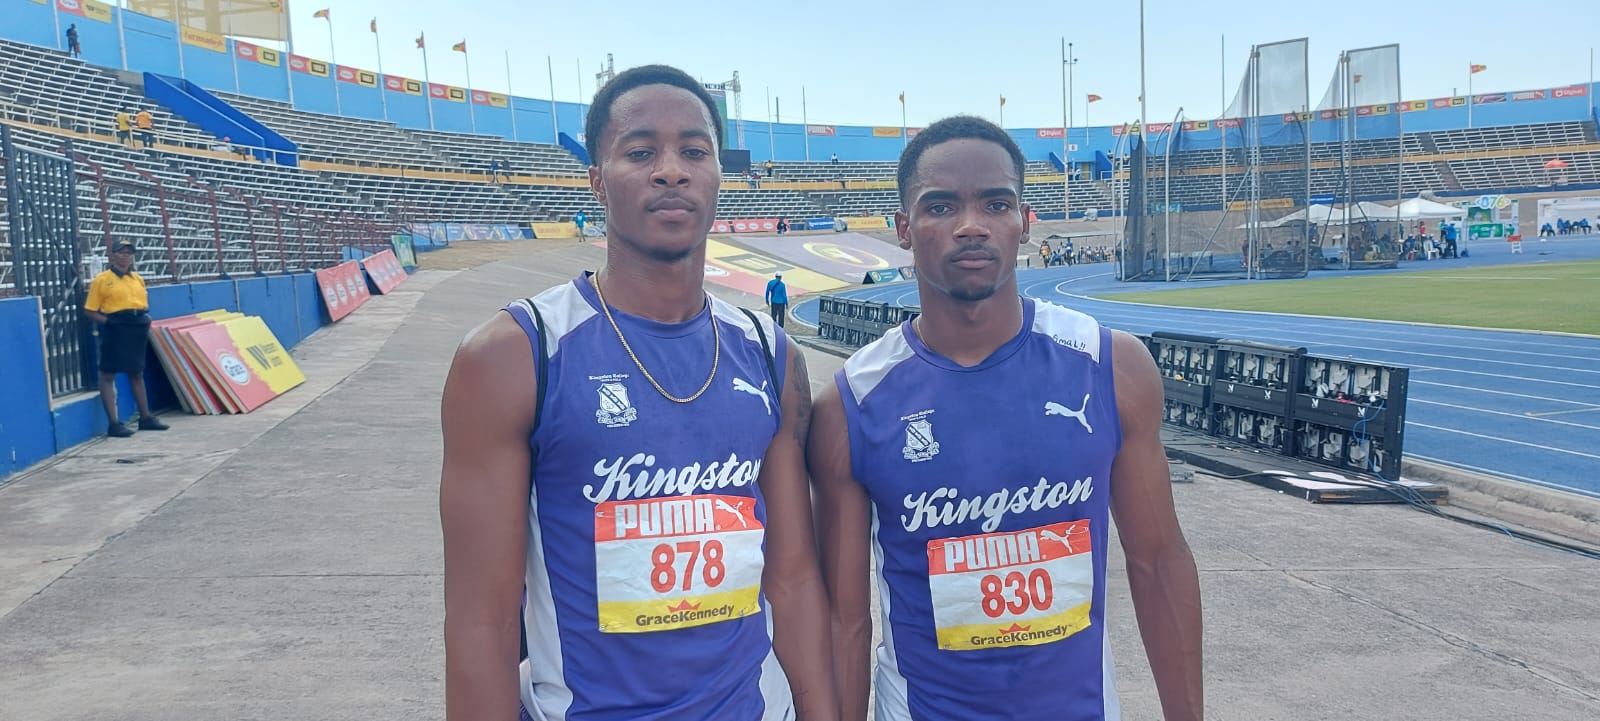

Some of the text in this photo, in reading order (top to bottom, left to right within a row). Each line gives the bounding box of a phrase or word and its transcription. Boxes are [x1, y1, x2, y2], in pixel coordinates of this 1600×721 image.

[583, 452, 761, 503] Kingston
[615, 498, 715, 538] PUMA
[901, 476, 1093, 533] Kingston
[650, 539, 726, 593] 878
[943, 532, 1041, 572] PUMA
[980, 567, 1054, 618] 830
[636, 604, 735, 627] GraceKennedy
[970, 624, 1068, 646] GraceKennedy
